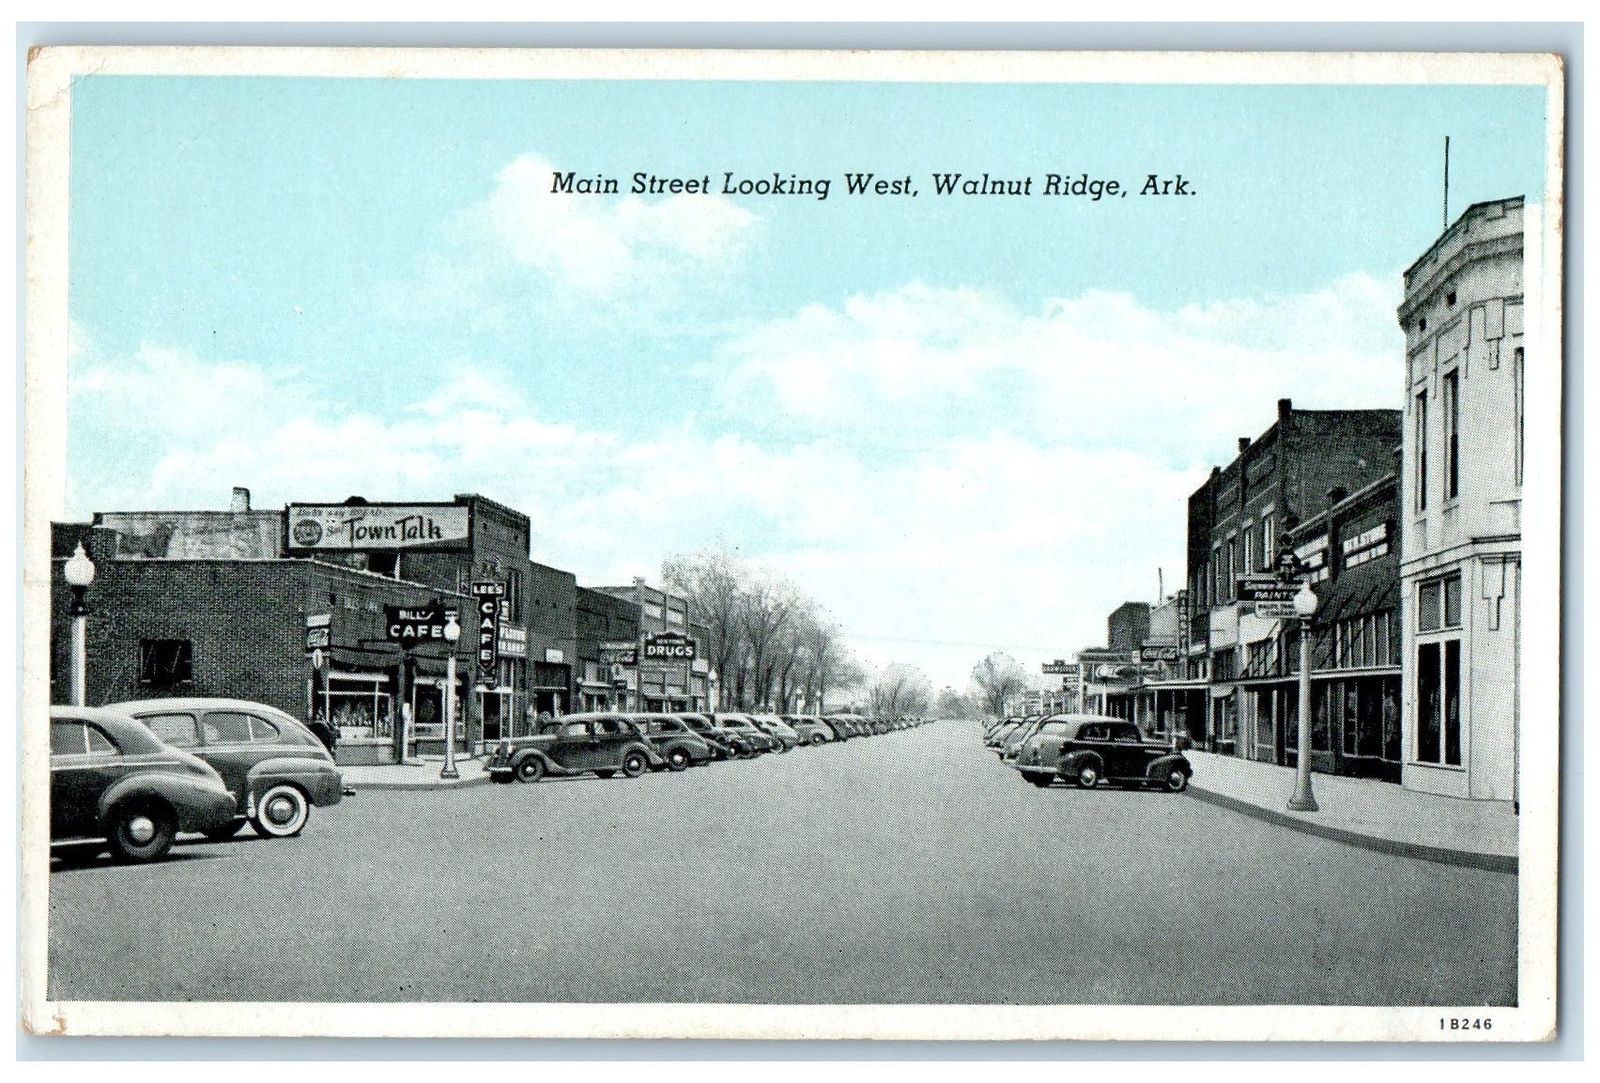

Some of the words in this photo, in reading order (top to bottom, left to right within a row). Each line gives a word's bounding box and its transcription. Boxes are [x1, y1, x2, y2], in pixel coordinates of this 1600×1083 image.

[342, 516, 397, 541] Town
[396, 515, 442, 542] Talk
[390, 625, 443, 638] CAFE
[480, 602, 494, 661] CAFE
[647, 645, 694, 657] DRUGS
